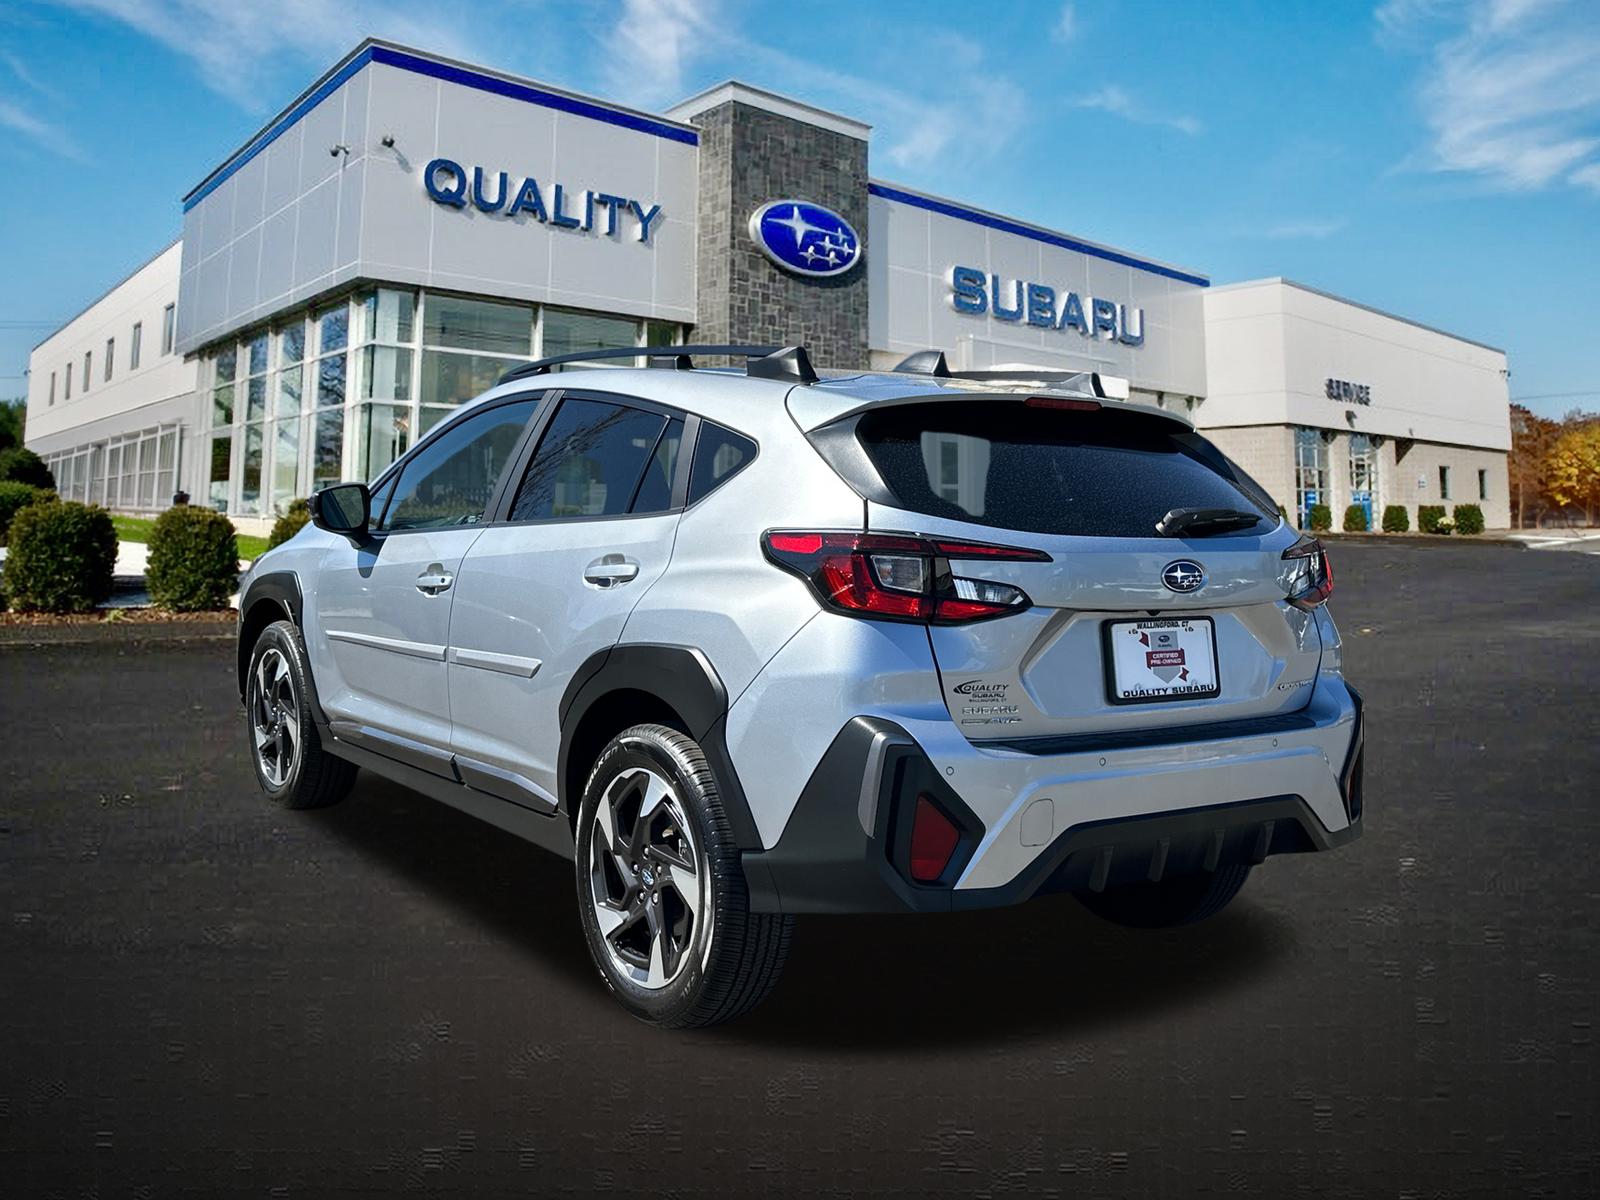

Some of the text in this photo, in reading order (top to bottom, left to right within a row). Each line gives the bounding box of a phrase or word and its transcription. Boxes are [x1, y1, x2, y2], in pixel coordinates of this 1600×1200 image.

[424, 158, 661, 242] QUALITY
[950, 265, 1145, 346] SUBARU
[1181, 620, 1189, 628] CT
[963, 684, 1009, 692] QUALITY
[1123, 684, 1215, 697] QUALITY SUBARU
[962, 705, 1019, 715] SUBARU
